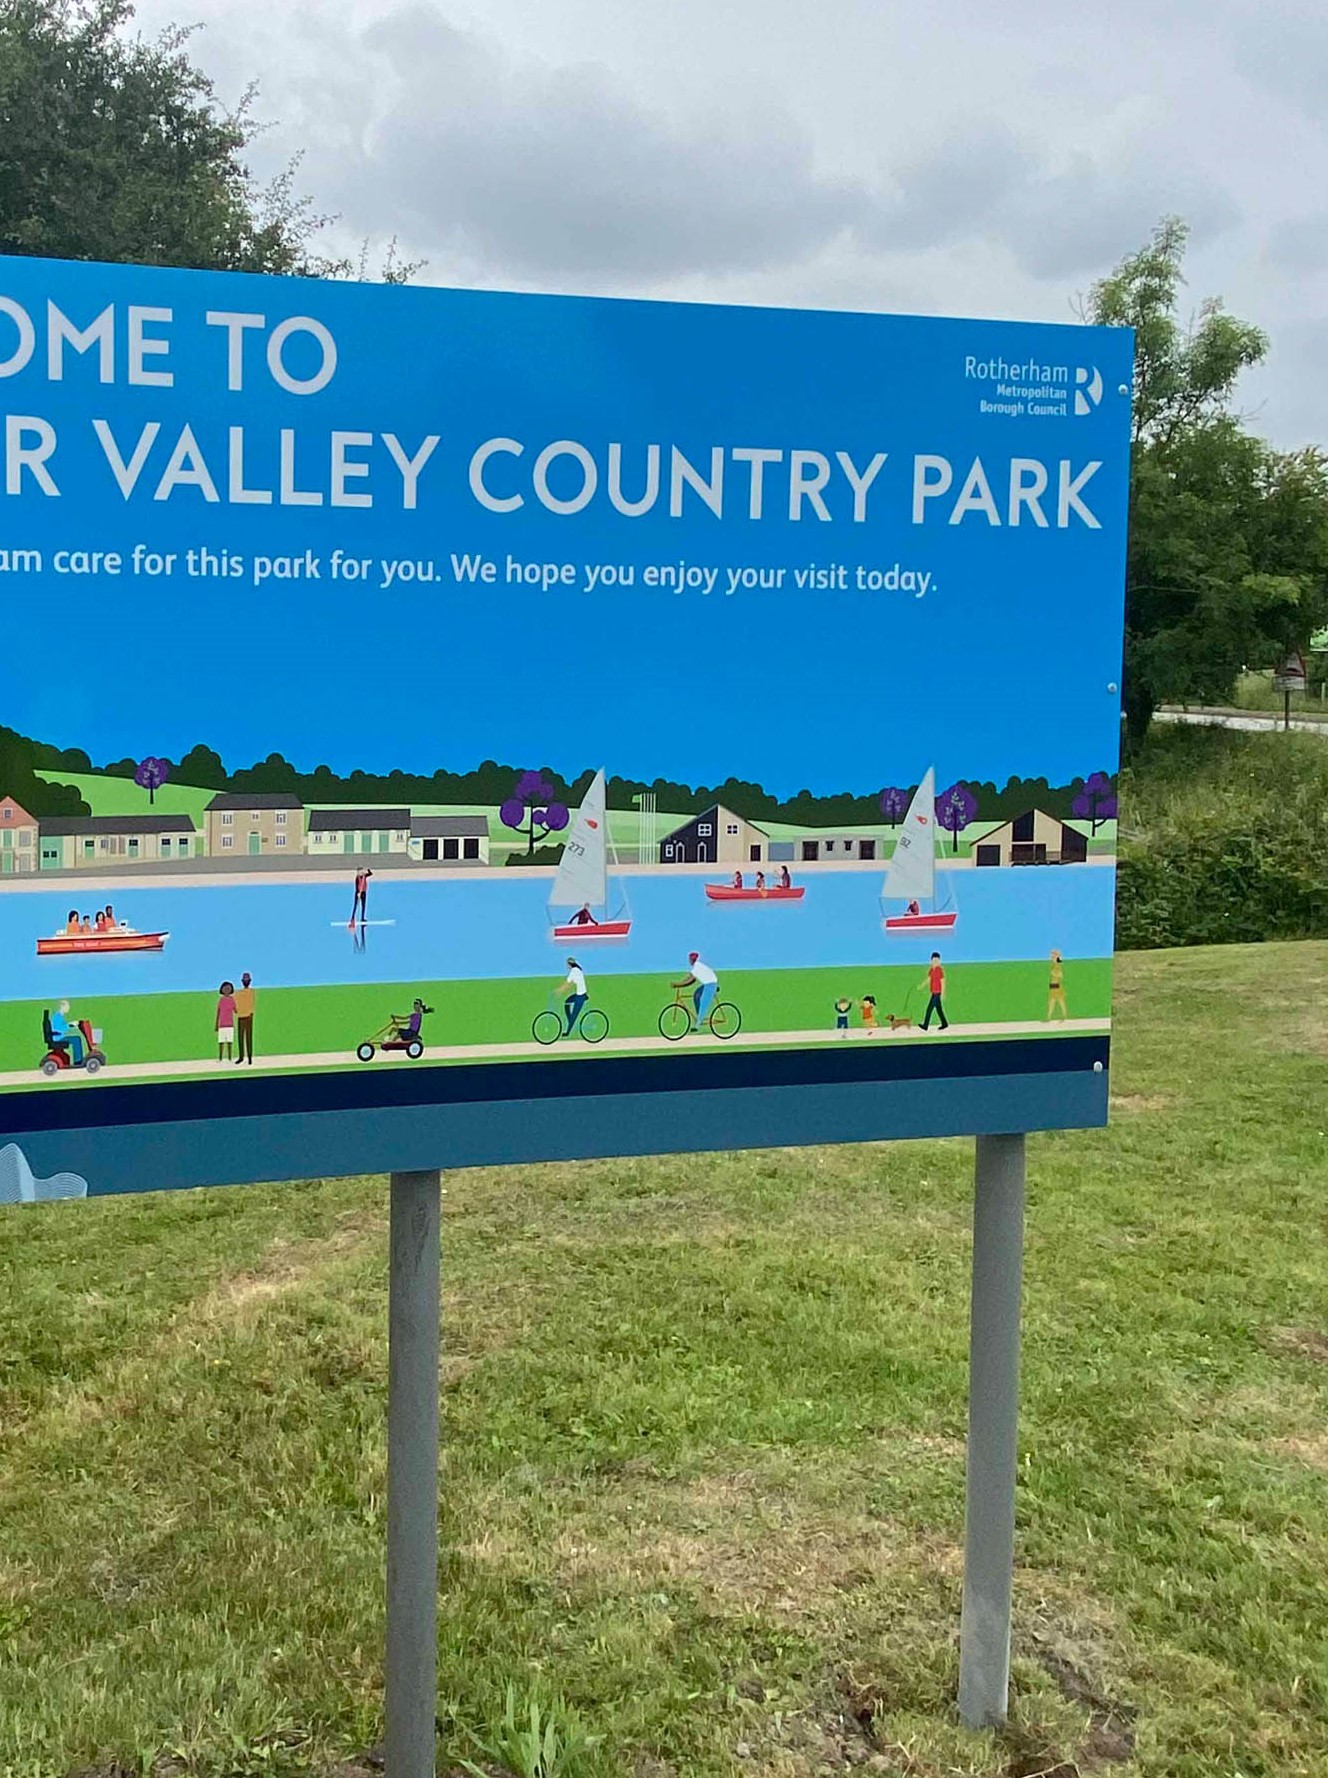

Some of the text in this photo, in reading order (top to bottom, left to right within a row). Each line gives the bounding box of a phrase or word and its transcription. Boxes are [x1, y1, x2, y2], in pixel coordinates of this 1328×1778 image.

[206, 311, 337, 395] TO
[965, 356, 1068, 382] Rotherham
[997, 384, 1067, 399] Metropolitan
[980, 400, 1067, 417] Borough Council
[93, 419, 441, 509] VALLEY
[469, 437, 887, 522] COUNTRY
[912, 455, 1102, 529] PARK
[53, 551, 122, 574] care
[132, 544, 174, 575] for
[186, 547, 243, 577] this
[254, 549, 320, 585] park
[330, 551, 372, 580] for
[381, 560, 442, 588] you.
[450, 554, 497, 583] We
[506, 556, 576, 591] hope
[584, 565, 635, 591] you
[643, 562, 718, 594] enjoy
[726, 567, 785, 594] your
[794, 563, 847, 590] visit
[856, 564, 938, 596] today.
[568, 841, 585, 857] 273
